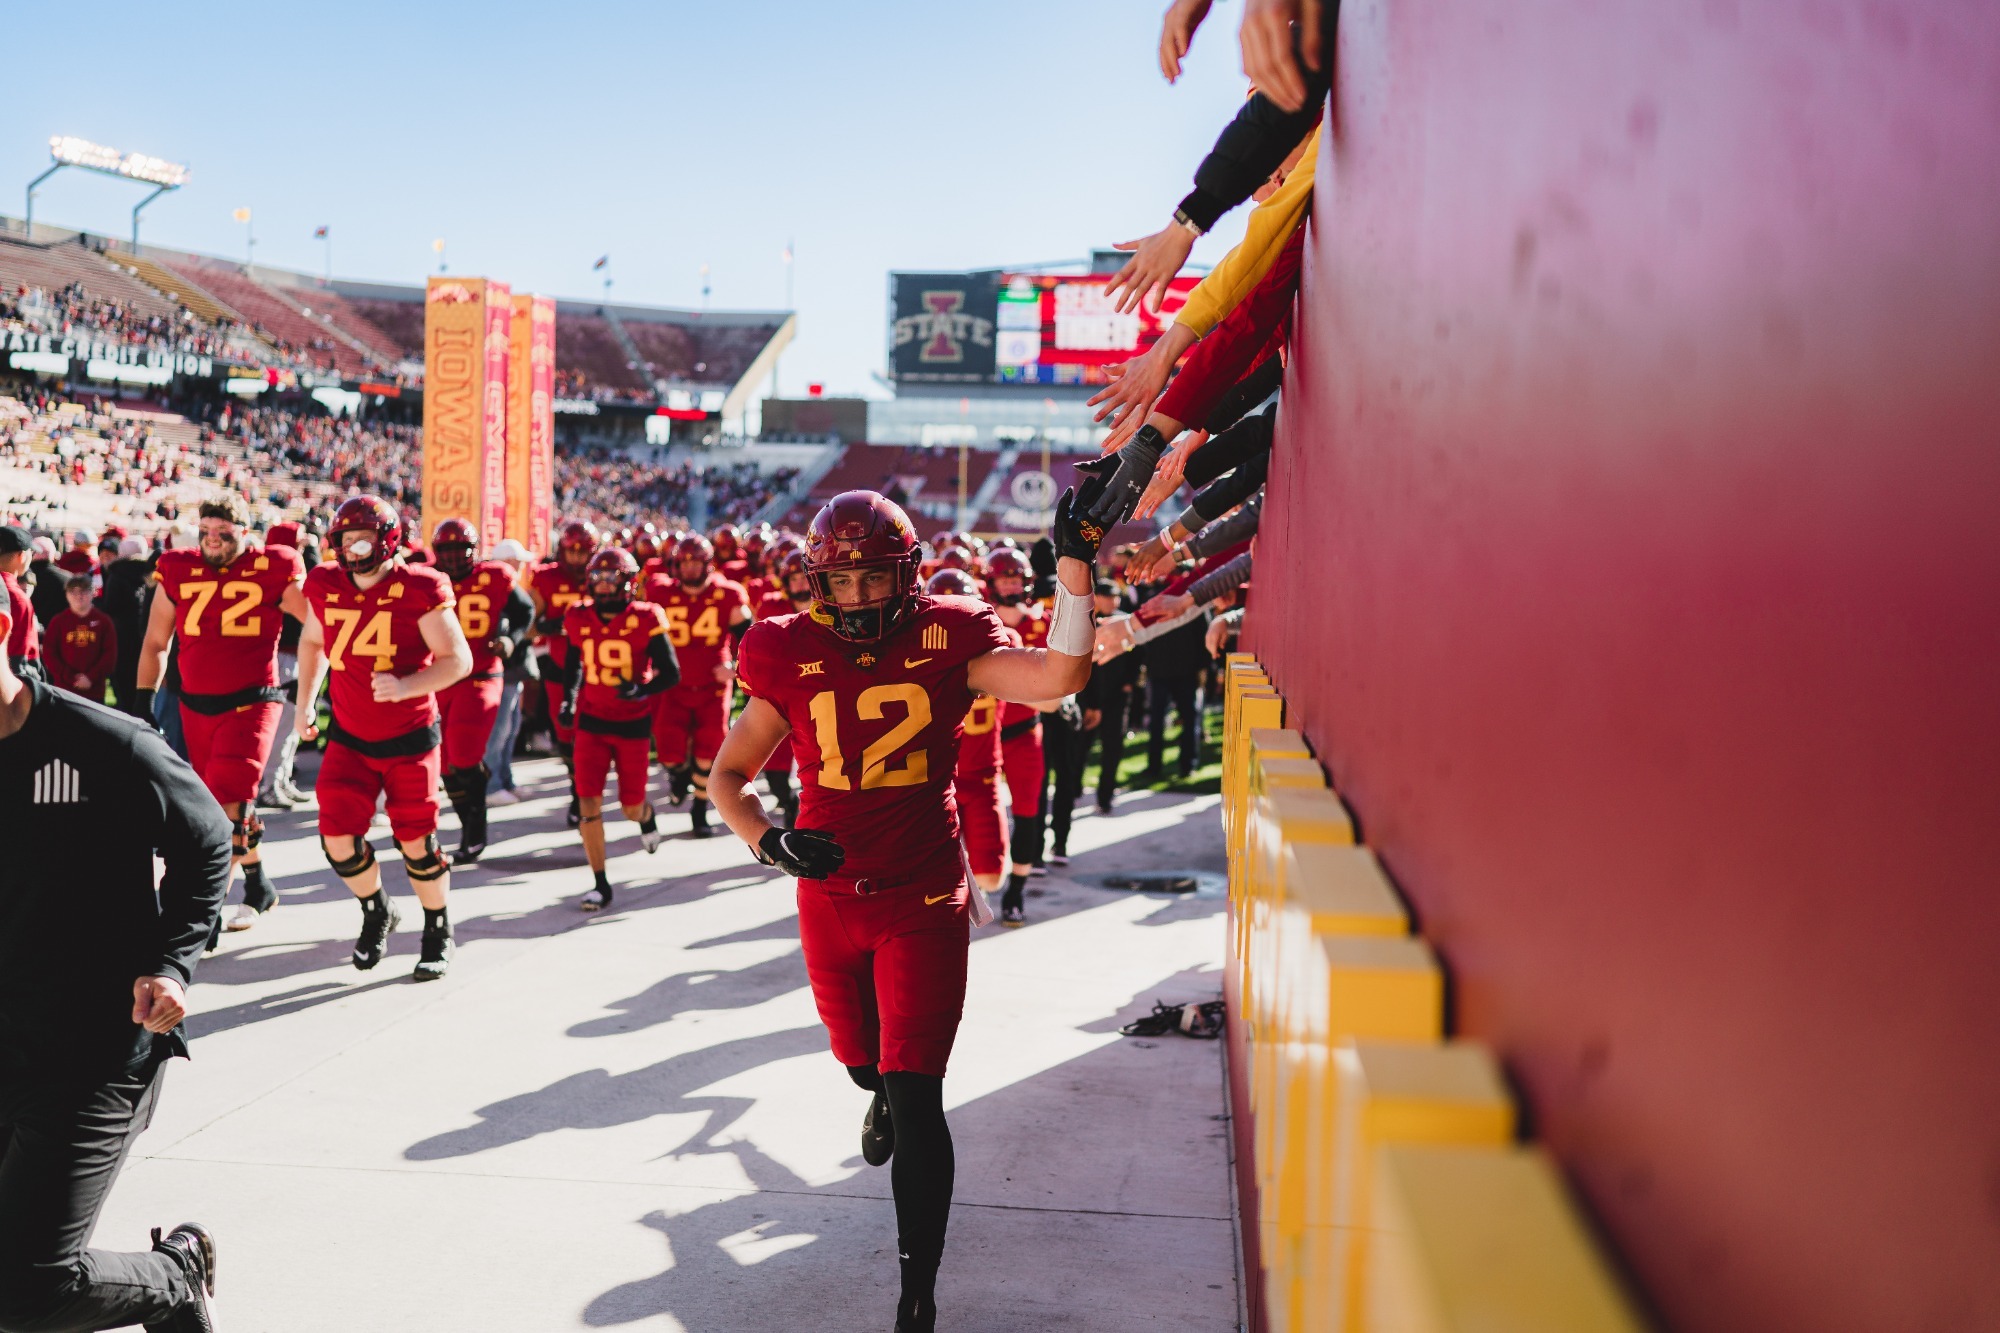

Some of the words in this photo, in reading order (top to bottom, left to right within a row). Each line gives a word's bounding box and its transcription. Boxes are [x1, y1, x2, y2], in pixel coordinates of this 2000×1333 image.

[895, 313, 993, 347] STATE
[61, 337, 140, 365] CREDIT
[147, 350, 213, 378] UNION
[433, 326, 474, 472] IOWA
[179, 580, 263, 637] 72
[665, 606, 722, 647] 54
[324, 608, 397, 672] 74
[582, 638, 633, 687] 19
[809, 682, 933, 791] 12
